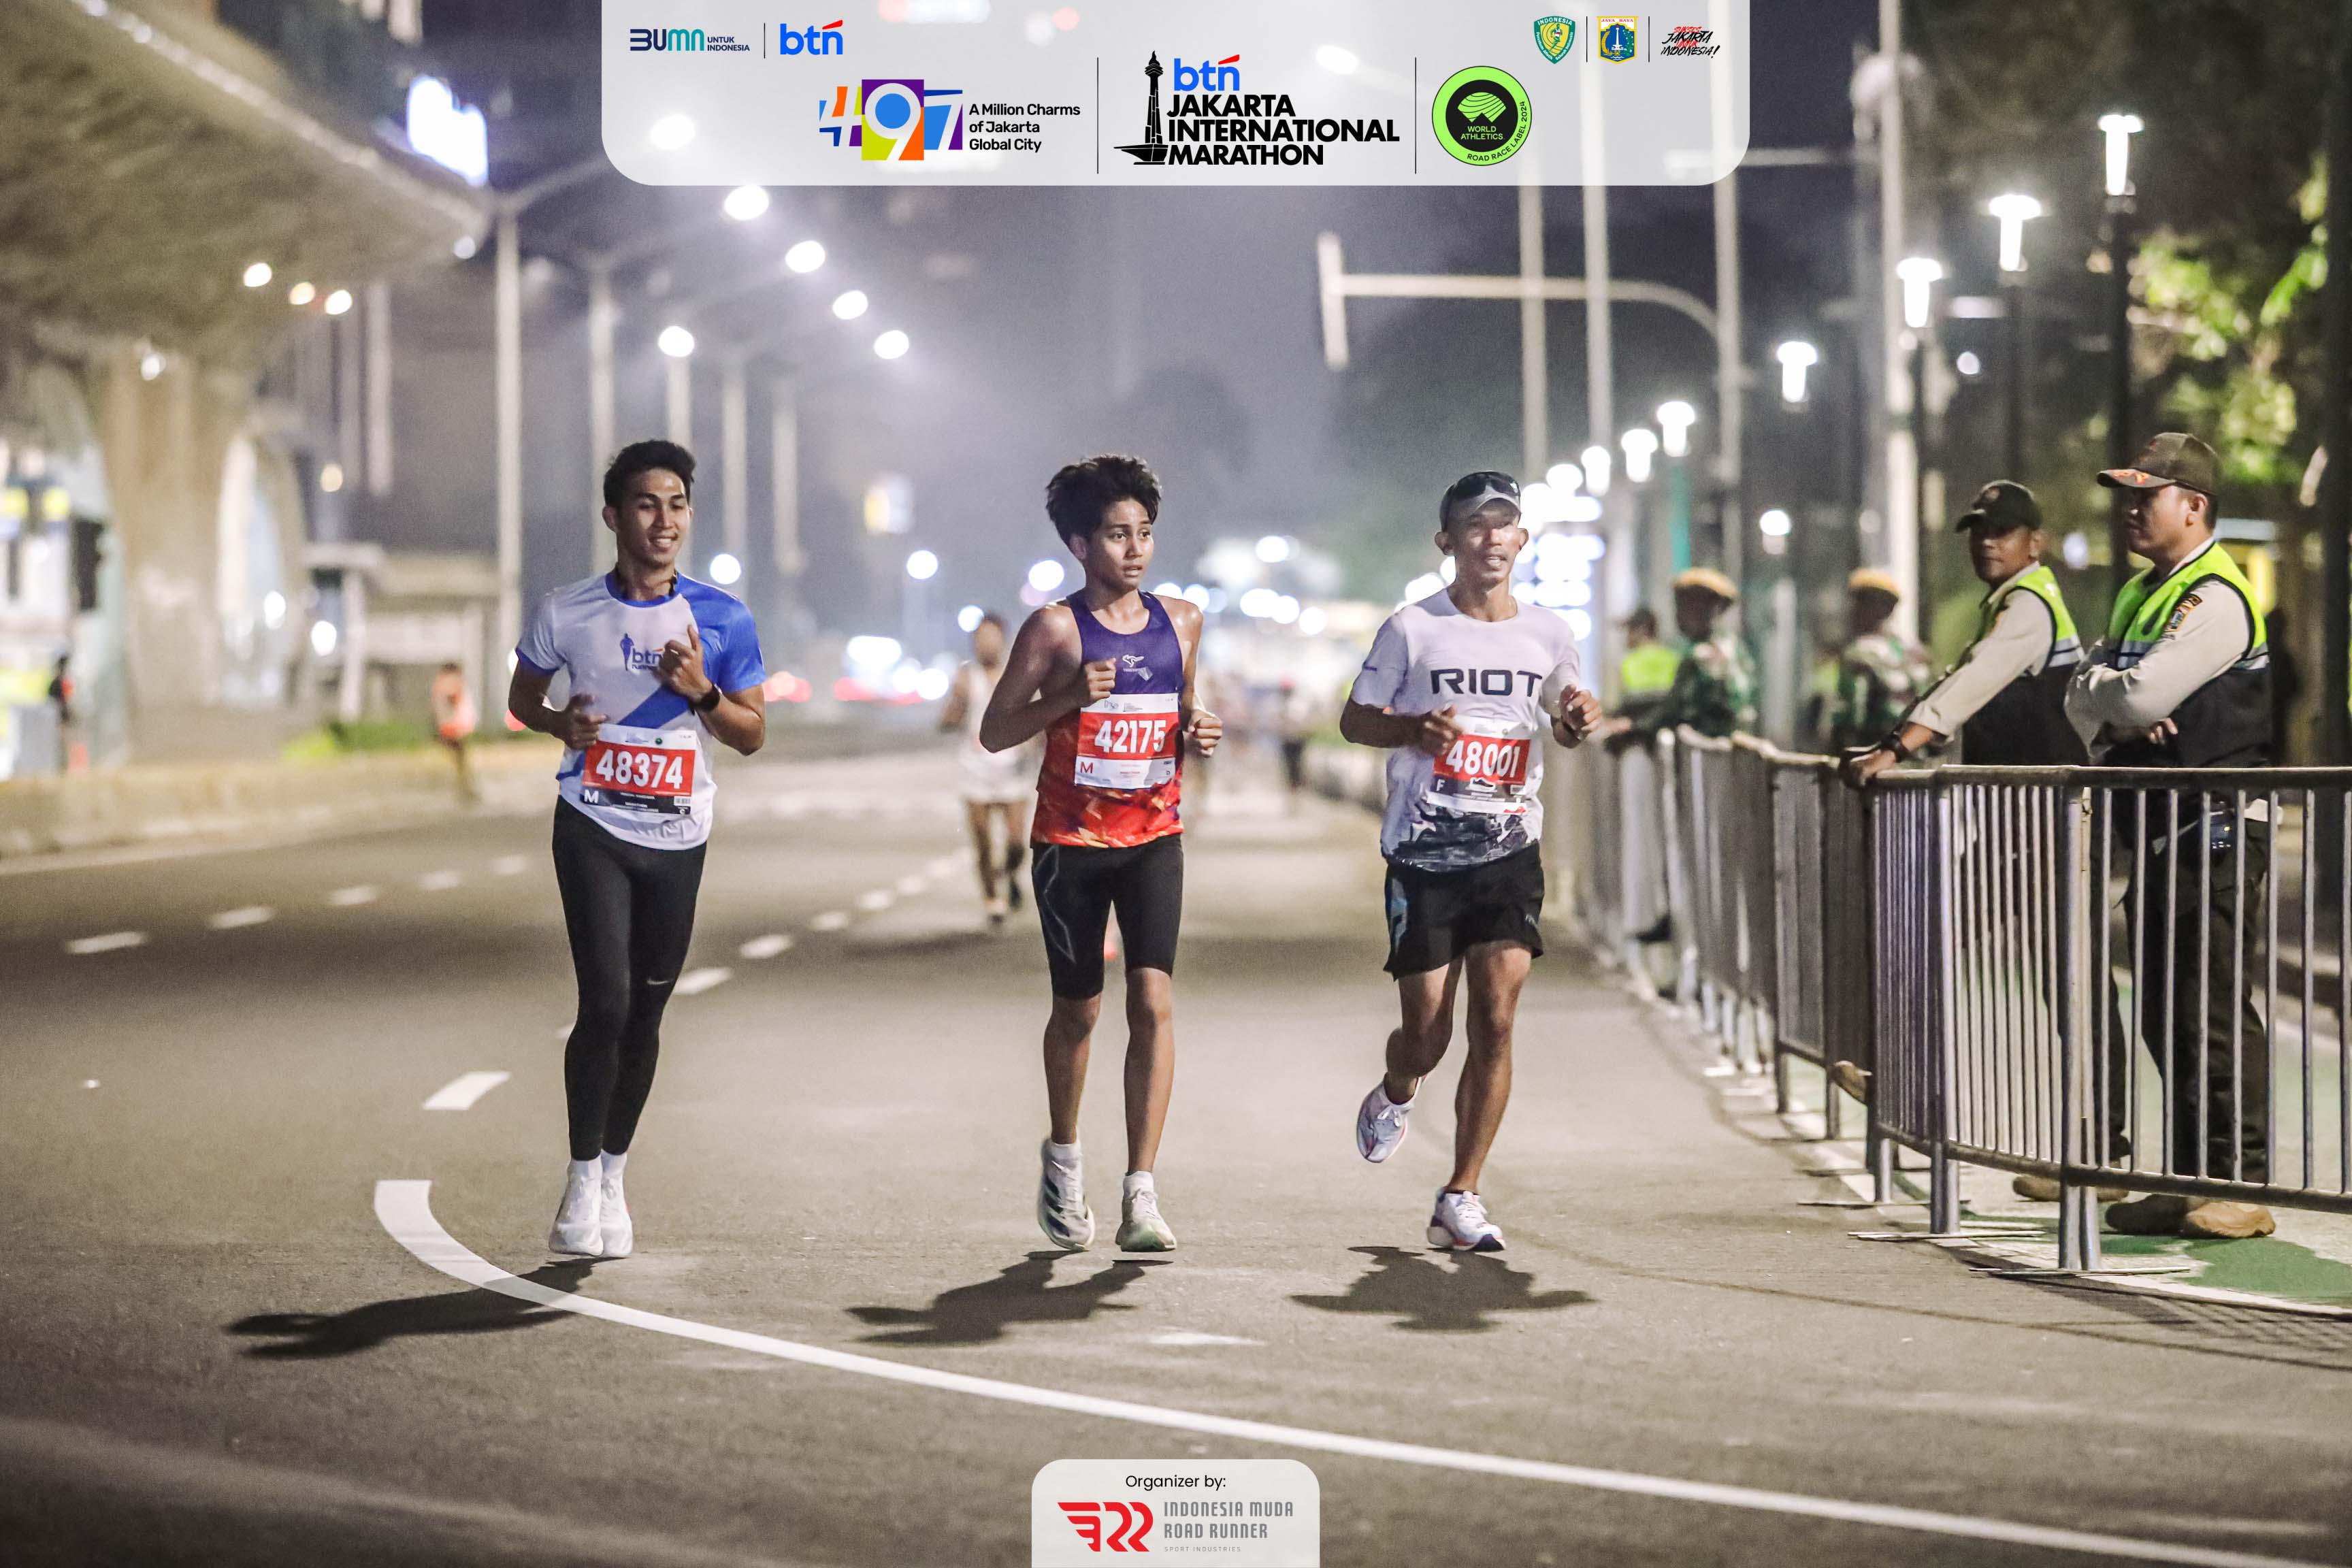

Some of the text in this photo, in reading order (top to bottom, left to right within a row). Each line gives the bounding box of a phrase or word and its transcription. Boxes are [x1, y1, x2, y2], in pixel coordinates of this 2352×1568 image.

[1431, 668, 1543, 697] RIOT
[1094, 719, 1166, 753] 42175
[596, 749, 683, 789] 48374
[1080, 762, 1094, 774] M
[1446, 740, 1520, 778] 48001
[584, 789, 600, 804] M
[1436, 779, 1446, 791] F
